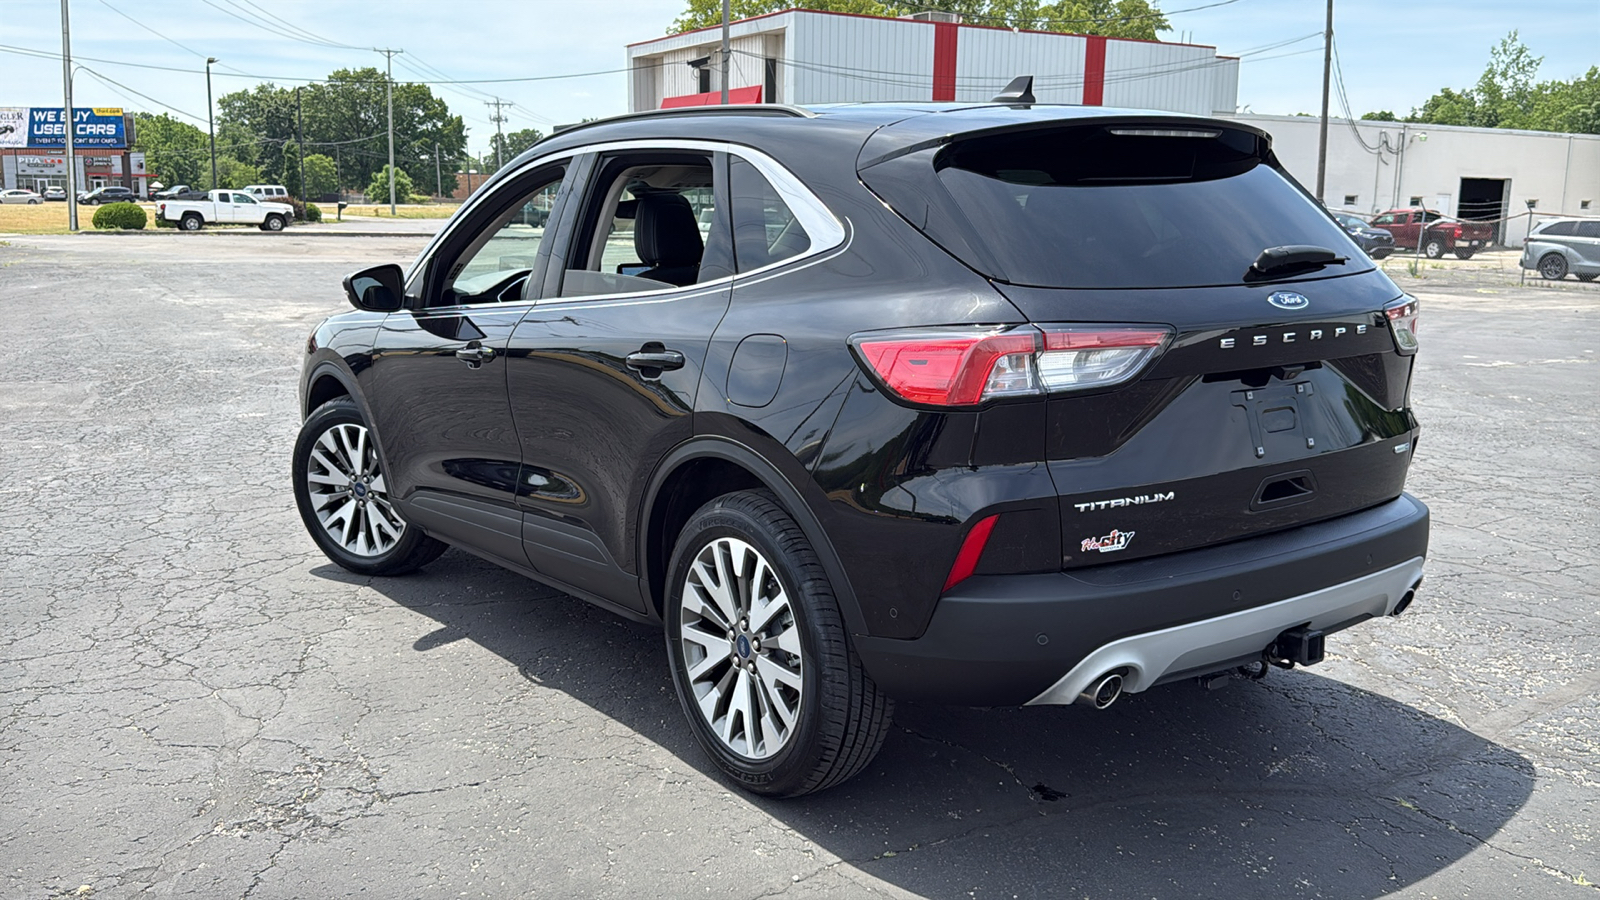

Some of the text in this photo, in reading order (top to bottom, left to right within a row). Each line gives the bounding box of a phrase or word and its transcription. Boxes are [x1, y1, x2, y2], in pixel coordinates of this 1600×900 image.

[33, 111, 56, 122] WE
[33, 124, 116, 135] USE CARS
[1278, 292, 1302, 305] Ford
[1219, 324, 1367, 349] ESCAPE
[1074, 491, 1175, 513] TITANIUM
